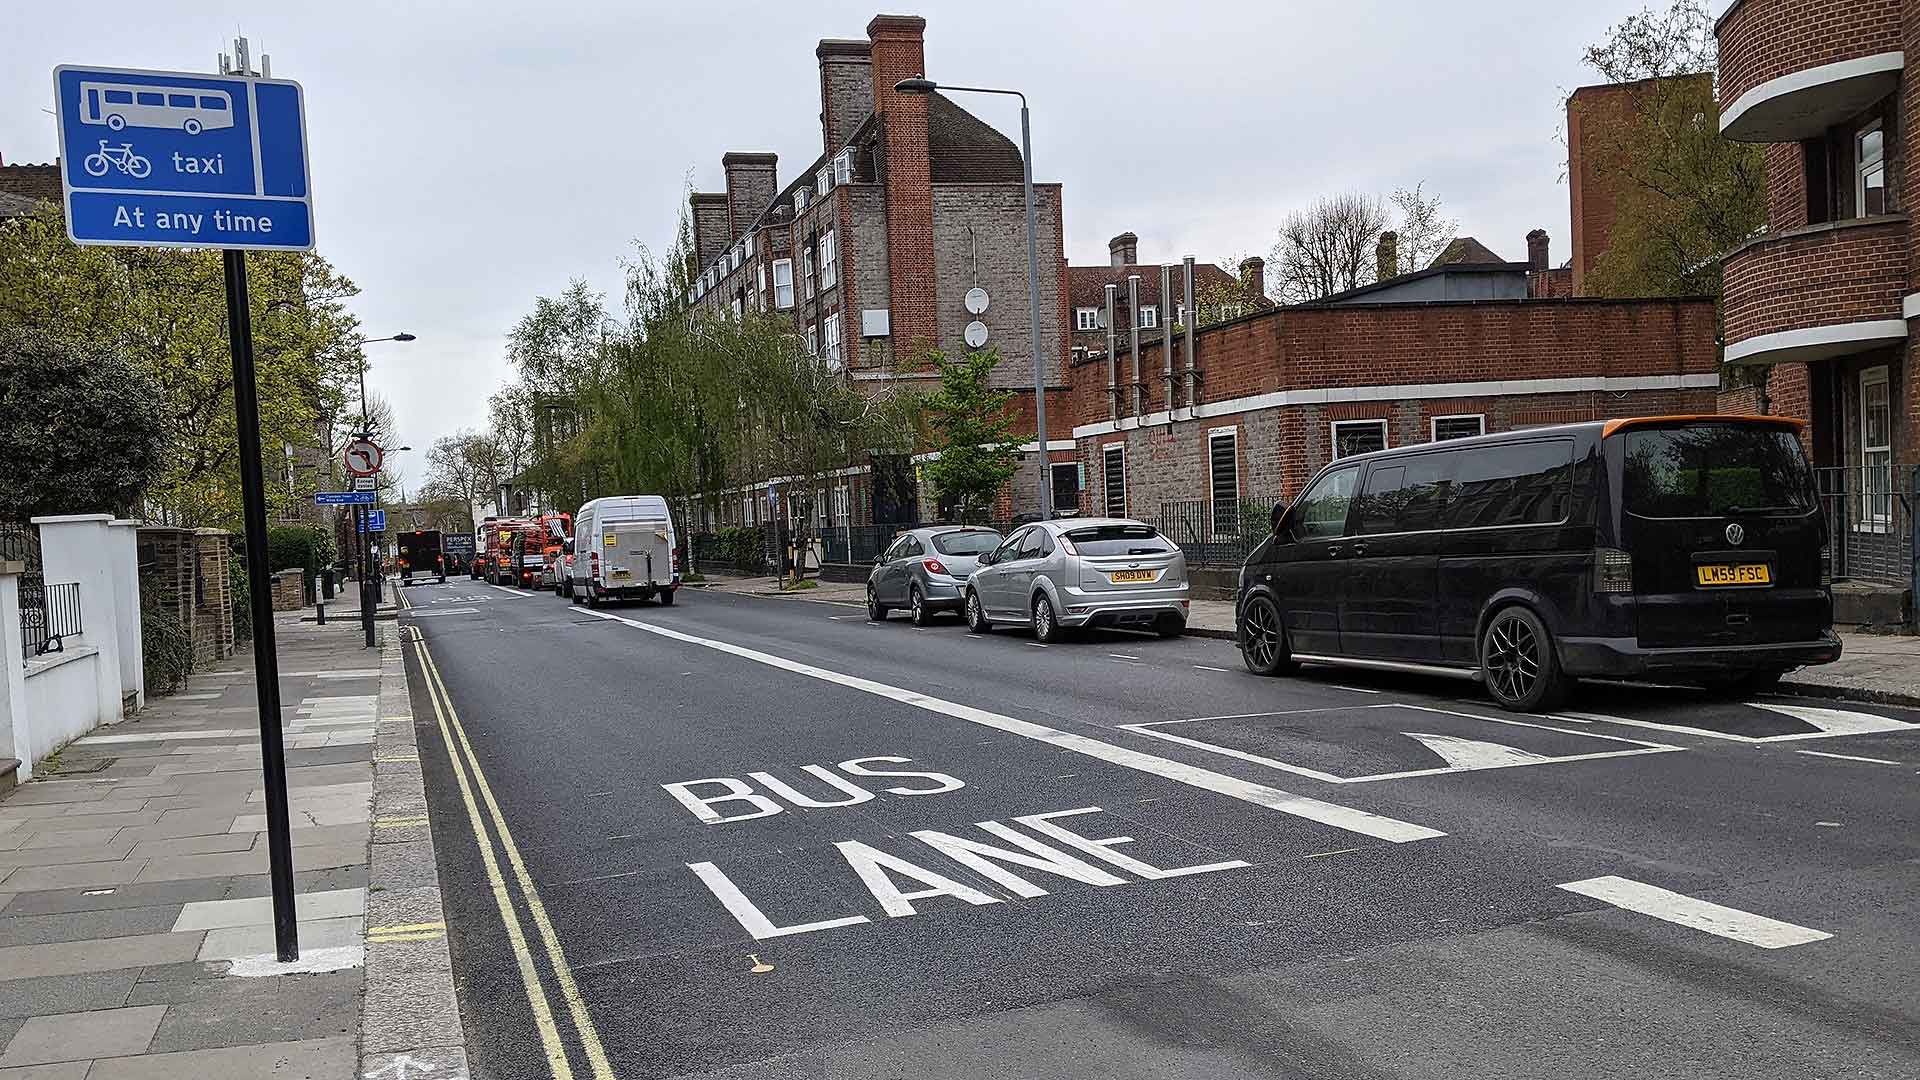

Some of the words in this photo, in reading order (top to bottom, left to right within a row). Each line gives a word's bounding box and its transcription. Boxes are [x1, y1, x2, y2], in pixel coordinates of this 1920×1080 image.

[172, 151, 224, 174] taxi
[113, 206, 145, 228] At
[156, 212, 203, 234] any
[214, 209, 273, 233] time
[1115, 571, 1135, 580] SH09
[1702, 567, 1736, 582] LM59
[1739, 567, 1763, 581] FSC
[660, 756, 966, 825] BUS
[686, 806, 1253, 941] LANE
